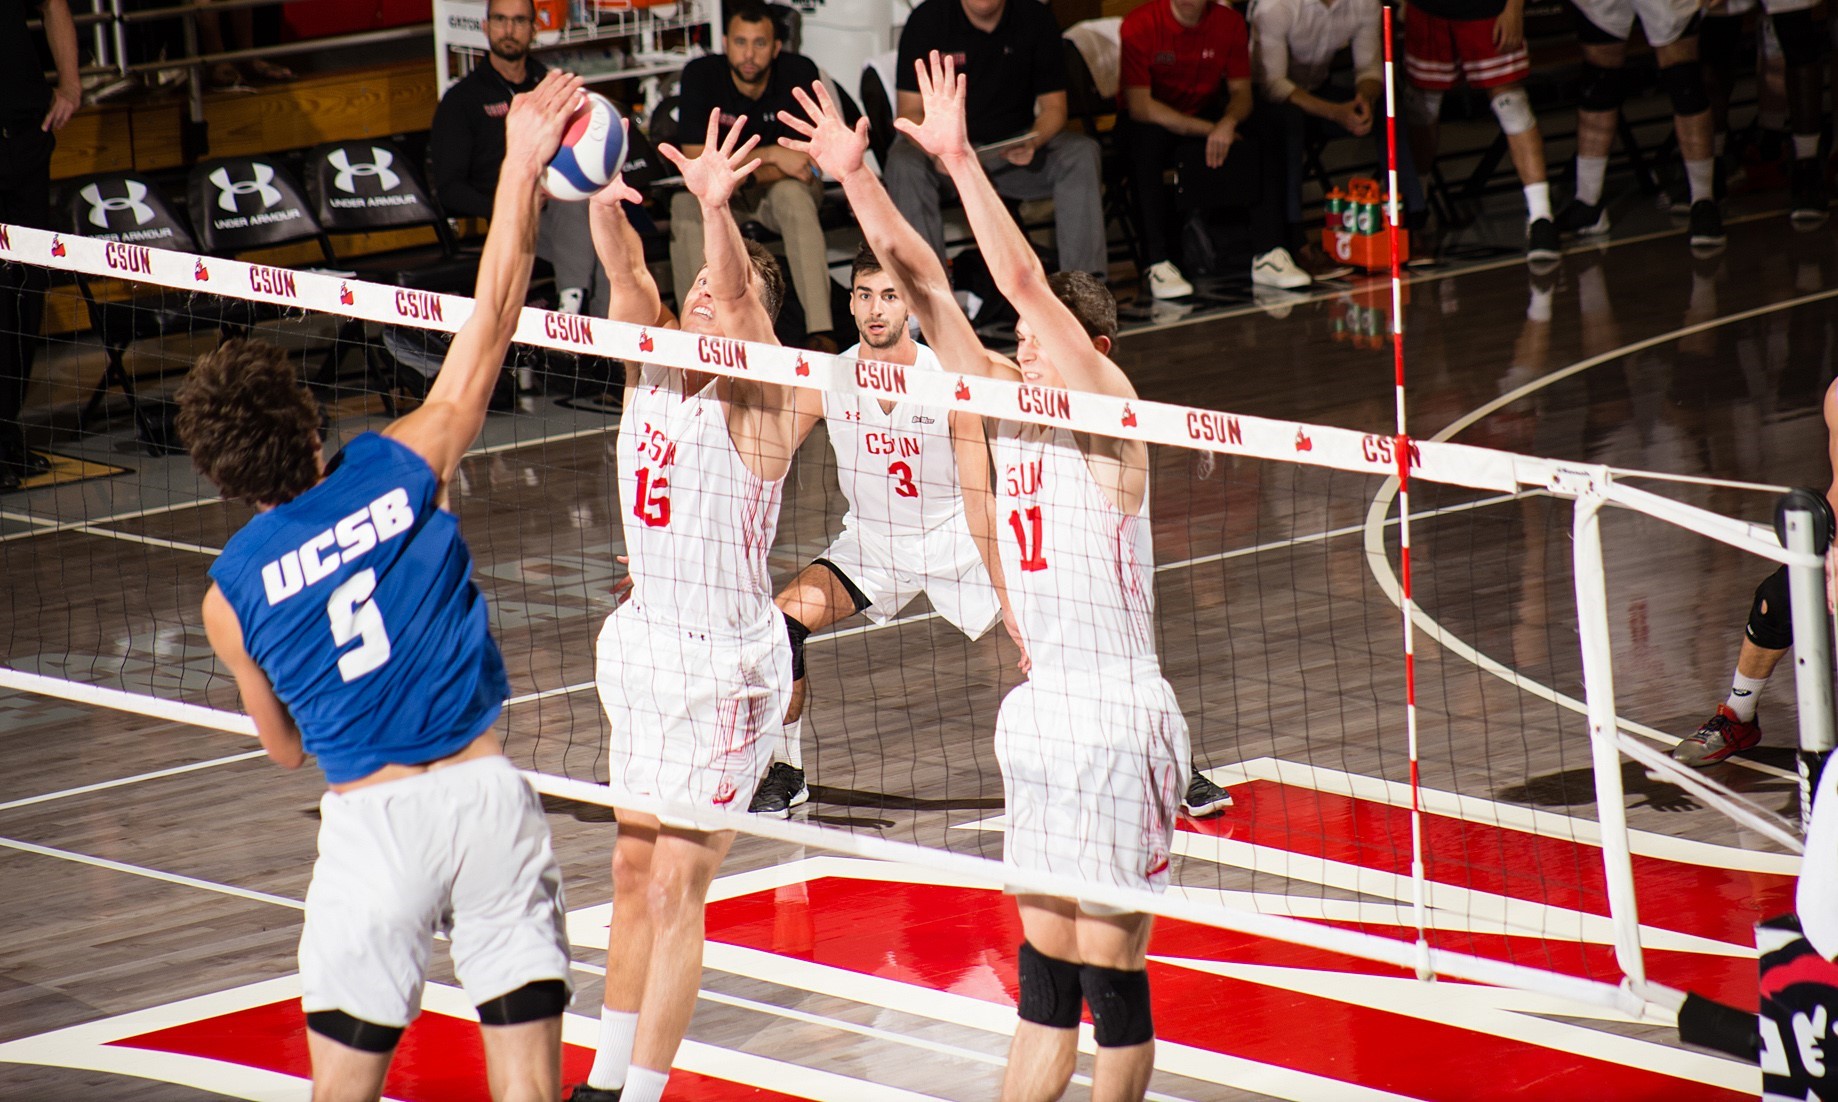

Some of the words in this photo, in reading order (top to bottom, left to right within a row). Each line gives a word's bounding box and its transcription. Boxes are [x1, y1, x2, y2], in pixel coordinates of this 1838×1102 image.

[448, 15, 483, 31] GATOR
[622, 159, 647, 172] OUR
[329, 198, 366, 208] UNDER
[367, 194, 417, 207] ARMOUR
[121, 227, 173, 242] ARMOUR
[214, 216, 249, 230] UNDER
[249, 208, 300, 226] ARMOUR
[105, 242, 152, 275] CSUN
[249, 265, 297, 298] CSUN
[395, 289, 443, 322] CSUN
[545, 312, 594, 346] CSUN
[698, 335, 748, 370] CSUN
[855, 360, 907, 394] CSUN
[1017, 385, 1071, 420] CSUN
[1186, 411, 1243, 446] CSUN
[1362, 435, 1421, 468] CSN
[888, 461, 919, 498] 3
[1006, 458, 1043, 497] SU
[633, 466, 671, 528] 15
[261, 487, 415, 607] UCSB
[1008, 505, 1048, 573] 11
[326, 566, 392, 684] 5
